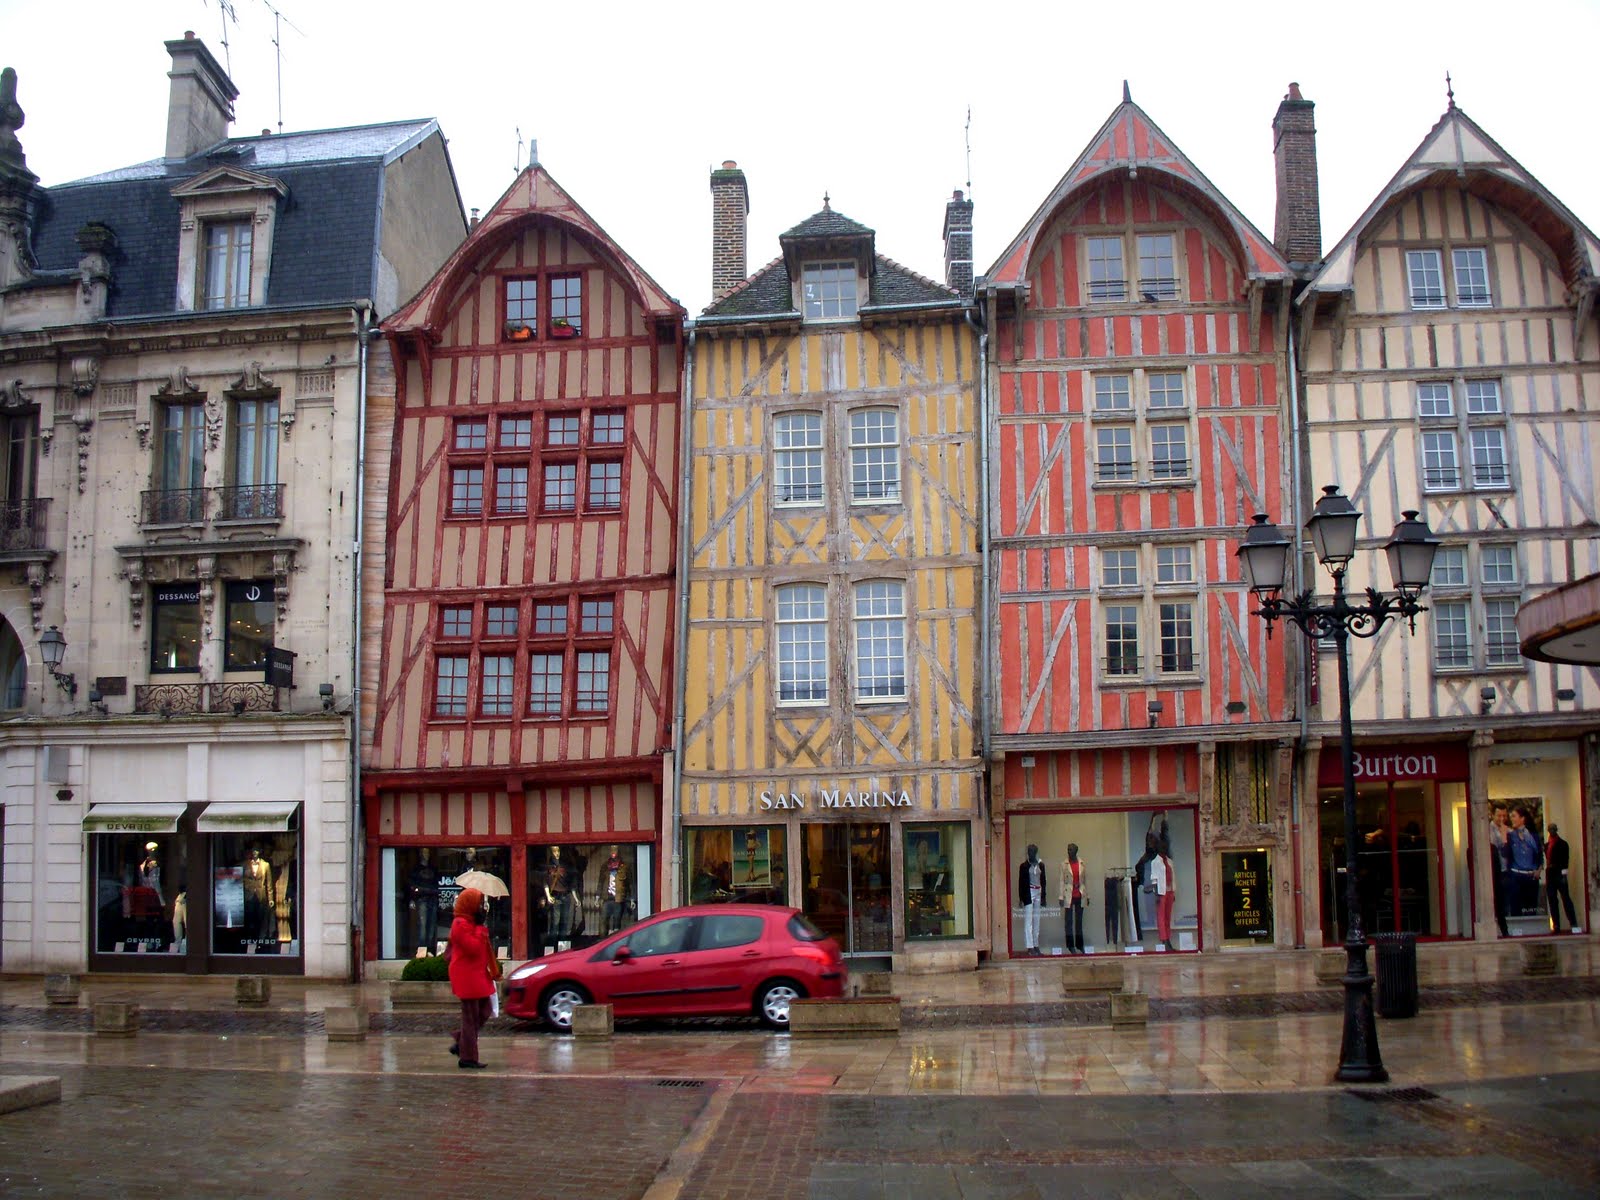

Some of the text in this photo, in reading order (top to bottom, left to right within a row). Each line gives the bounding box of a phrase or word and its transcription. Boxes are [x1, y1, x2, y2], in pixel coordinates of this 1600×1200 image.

[159, 592, 200, 601] DESSANGE
[1352, 751, 1437, 777] Burton
[760, 789, 913, 810] SAN MARINA
[1242, 858, 1248, 870] 1
[1242, 897, 1251, 909] 2
